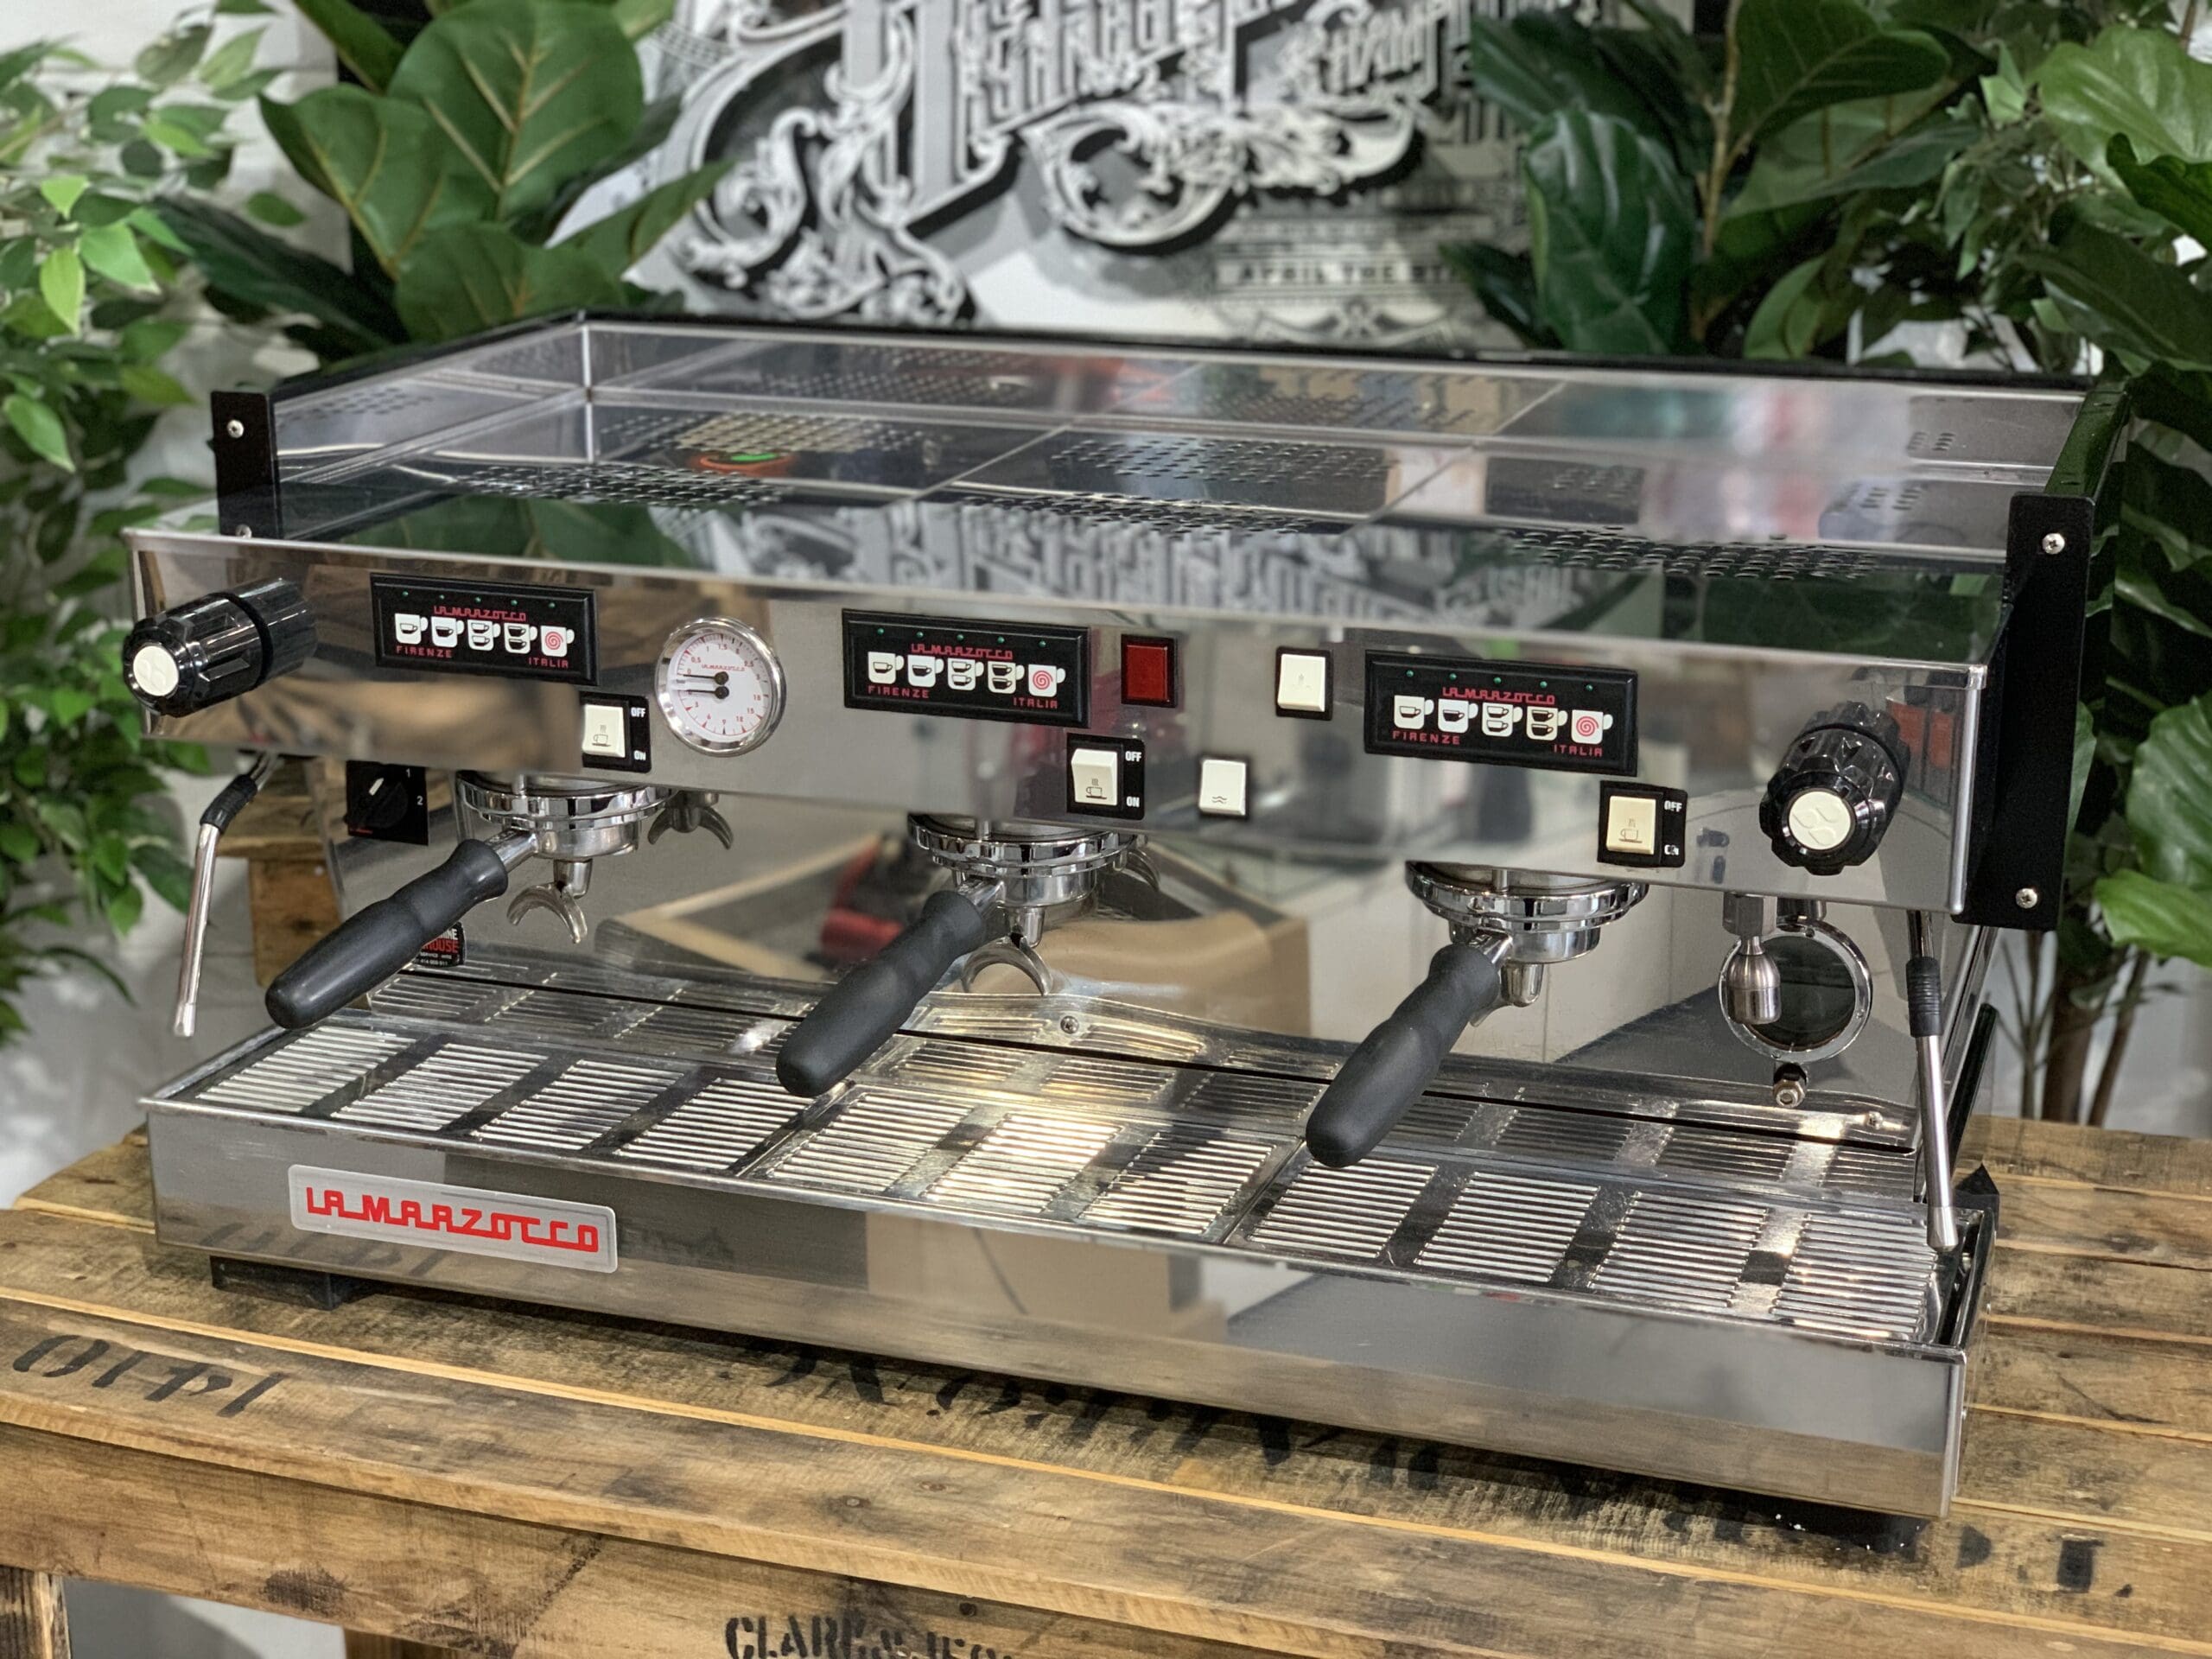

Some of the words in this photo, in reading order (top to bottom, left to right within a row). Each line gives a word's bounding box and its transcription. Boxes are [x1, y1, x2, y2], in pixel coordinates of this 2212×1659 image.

[396, 646, 453, 658] FIRENZE
[528, 657, 569, 668] ITALIA
[868, 685, 929, 699] FIRENZE
[1013, 696, 1058, 709] ITALIA
[631, 707, 646, 718] OFF
[1392, 730, 1460, 746] FIRENZE
[634, 750, 646, 762] ON
[1125, 750, 1142, 763] OFF
[1554, 744, 1603, 757] ITALIA
[416, 795, 424, 806] 2
[1126, 795, 1141, 809] ON
[1663, 800, 1683, 812] OFF
[306, 1186, 344, 1217] LA
[361, 1194, 599, 1253] MARZOCCO
